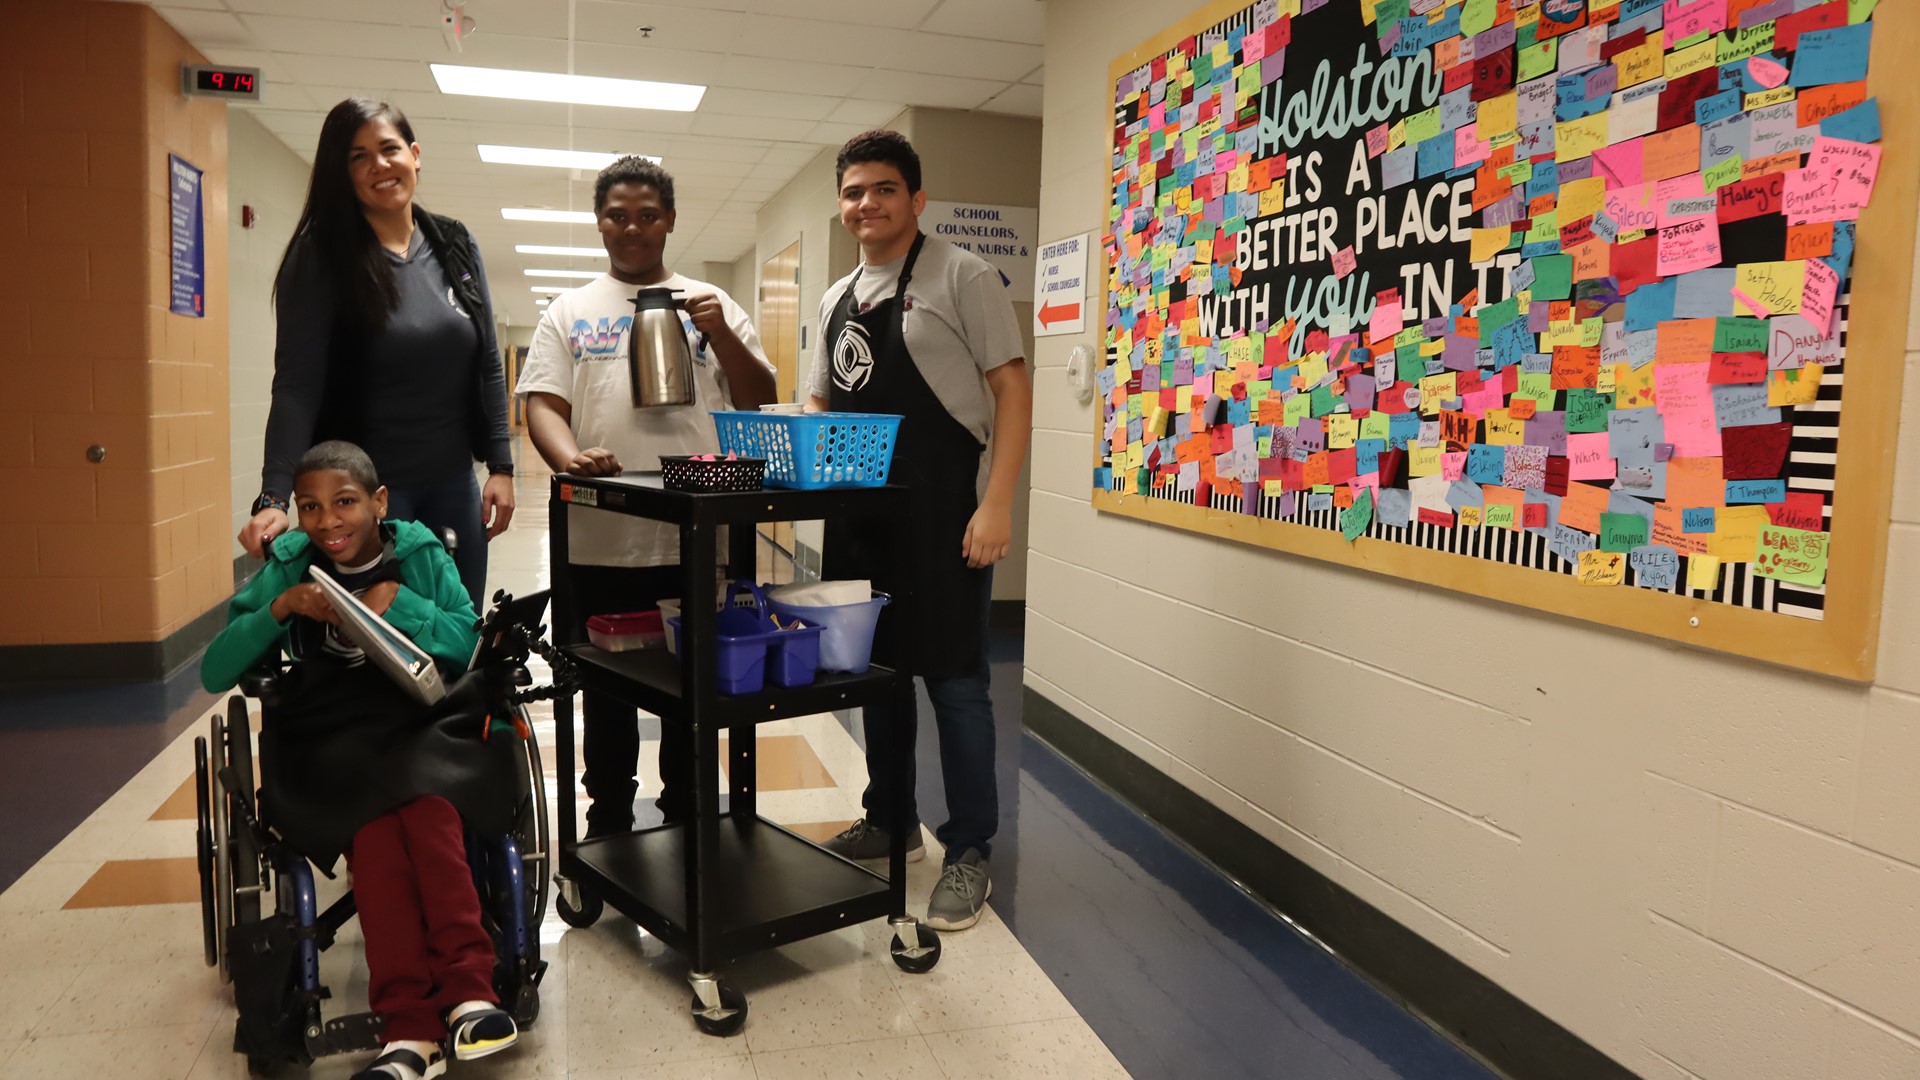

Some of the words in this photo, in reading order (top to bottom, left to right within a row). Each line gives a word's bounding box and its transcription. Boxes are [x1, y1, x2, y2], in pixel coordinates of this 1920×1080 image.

[1257, 42, 1444, 160] Holston
[1285, 151, 1323, 208] IS
[1345, 138, 1372, 196] A
[1720, 185, 1769, 213] Haley
[1769, 180, 1783, 198] C
[953, 207, 1002, 221] SCHOOL
[936, 223, 1018, 240] COUNSELORS,
[1236, 206, 1339, 272] BETTER
[1356, 177, 1476, 255] PLACE
[977, 243, 1016, 256] NURSE
[1020, 246, 1029, 257] &
[1042, 246, 1057, 261] ENTER
[1056, 242, 1069, 258] HERE
[1048, 265, 1059, 277] NURSE
[1747, 264, 1775, 285] Seth
[1046, 281, 1060, 293] SCHOOL
[1059, 277, 1081, 291] COUNSELORS
[1198, 281, 1271, 338] WITH
[1284, 271, 1378, 363] you
[1400, 258, 1455, 321] IN
[1470, 252, 1522, 318] IT
[1759, 284, 1800, 314] Hodge
[1725, 330, 1761, 350] Isaiah
[1575, 452, 1601, 465] White
[1739, 485, 1778, 501] Thompson
[1487, 507, 1514, 524] Emma
[1776, 507, 1820, 529] Addison
[1640, 569, 1669, 587] Ryan
